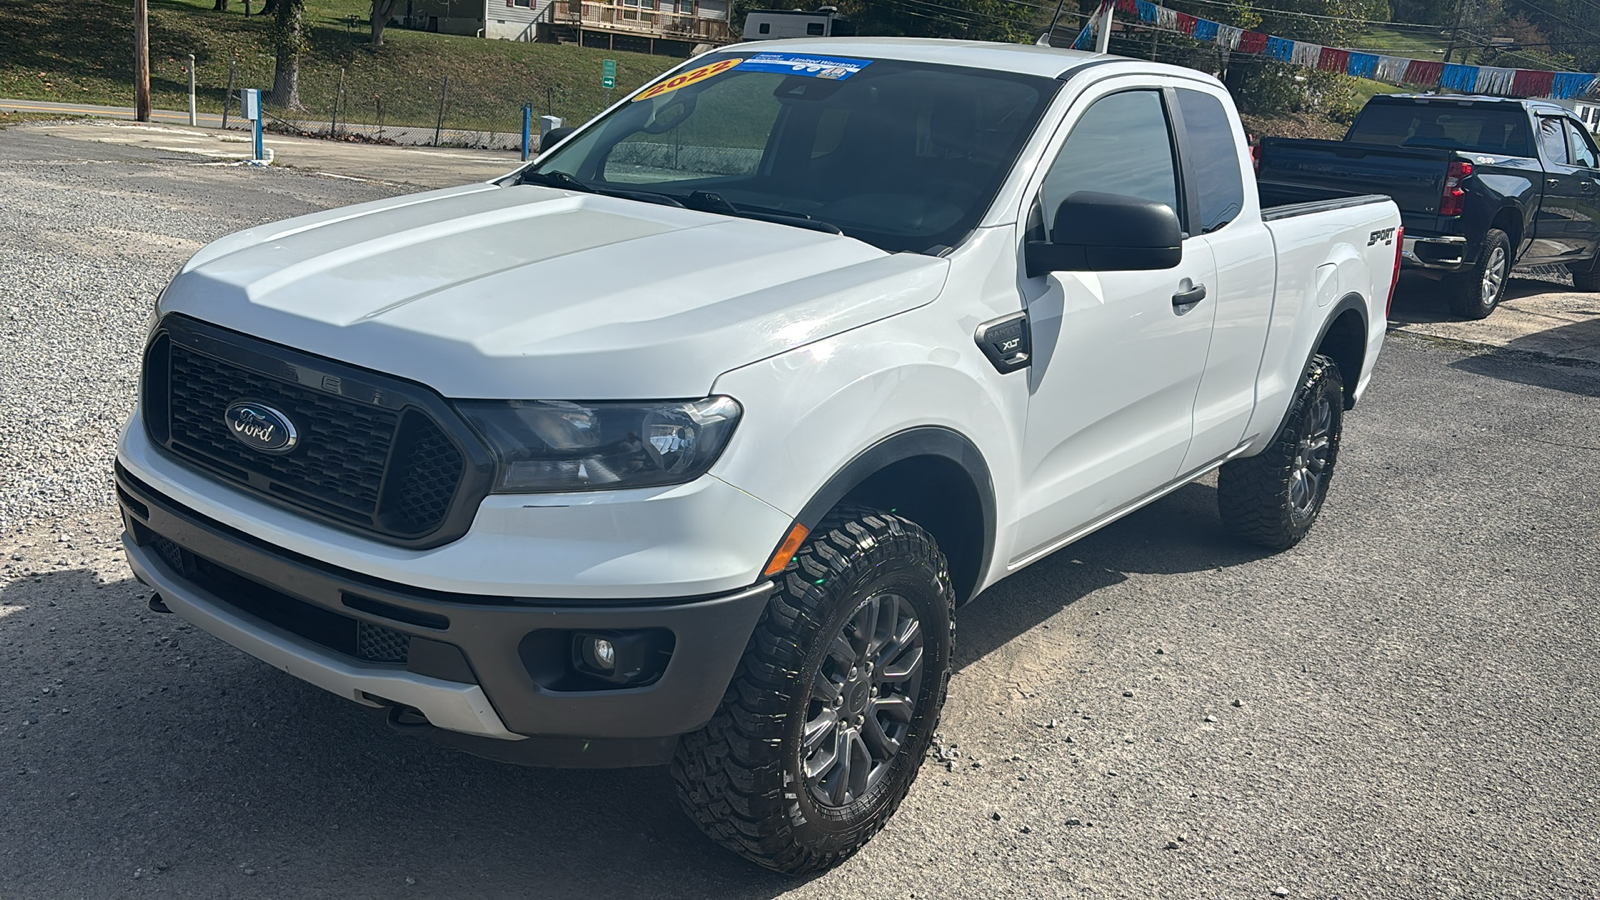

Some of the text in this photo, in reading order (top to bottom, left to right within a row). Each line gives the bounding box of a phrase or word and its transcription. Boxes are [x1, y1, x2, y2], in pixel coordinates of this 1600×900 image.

[789, 57, 821, 65] Limited
[821, 59, 860, 69] Warranty
[644, 60, 732, 99] 2022
[1366, 226, 1396, 247] SPORT
[987, 324, 1021, 339] RANGER
[1002, 337, 1020, 351] XLT
[234, 408, 275, 443] Ford
